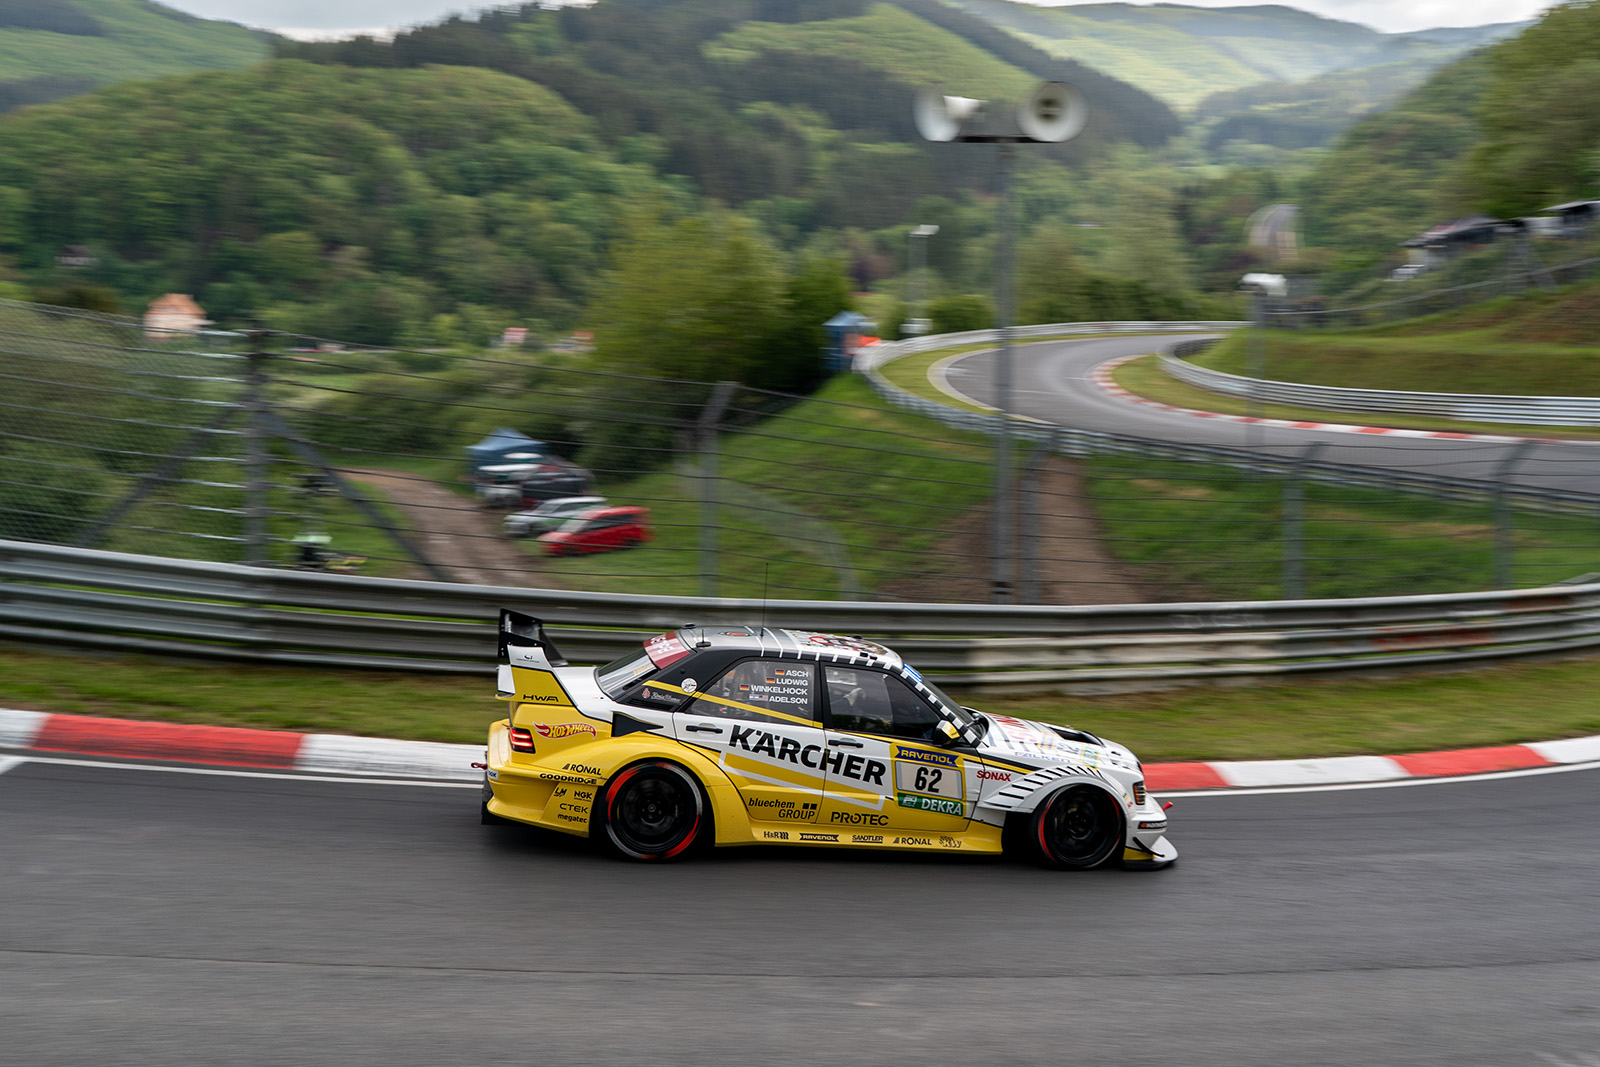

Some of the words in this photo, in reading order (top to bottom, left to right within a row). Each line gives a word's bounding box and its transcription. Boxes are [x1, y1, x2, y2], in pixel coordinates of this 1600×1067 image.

[776, 678, 808, 686] LUDWIG
[751, 685, 808, 695] WINKELHOCK
[522, 694, 559, 702] HWA
[769, 696, 808, 704] ADELSON
[728, 724, 886, 786] KÄRCHER
[901, 749, 953, 764] RAVENOL
[570, 764, 602, 775] RONAL
[540, 773, 597, 784] GOODRIDGE
[914, 766, 942, 793] 62
[976, 770, 1012, 782] SONAX
[574, 790, 592, 800] NGK
[560, 803, 588, 814] CTEK
[749, 798, 795, 809] bluechem
[920, 798, 962, 815] DEKRA
[558, 814, 587, 824] megatec
[778, 809, 816, 820] GROUP
[830, 812, 889, 826] PROTEC
[901, 837, 932, 846] RONAL
